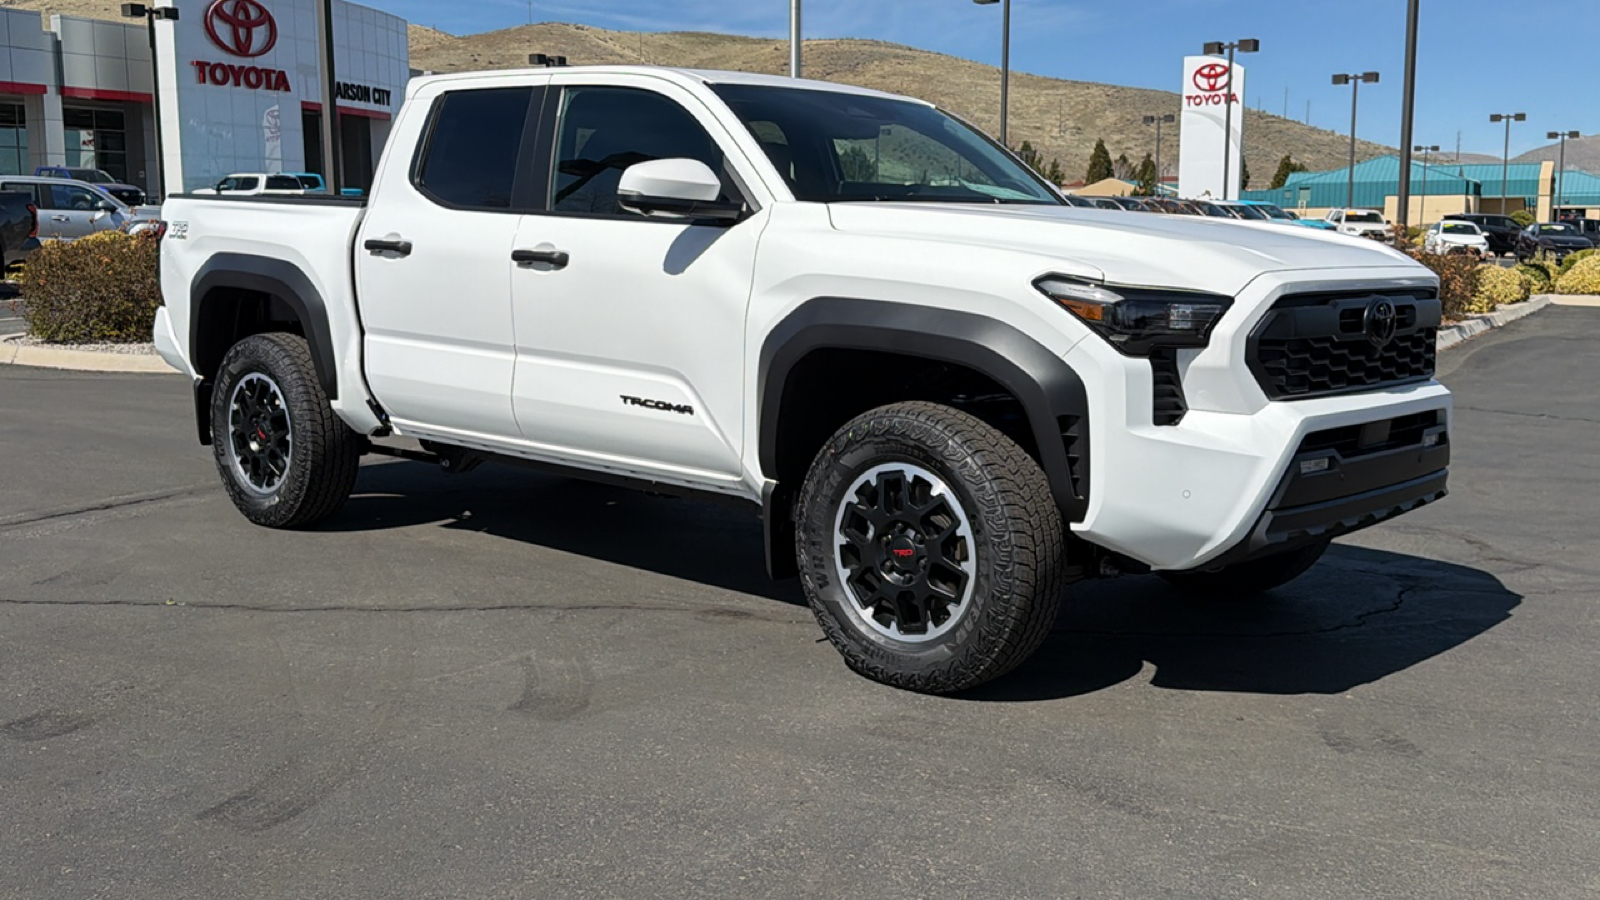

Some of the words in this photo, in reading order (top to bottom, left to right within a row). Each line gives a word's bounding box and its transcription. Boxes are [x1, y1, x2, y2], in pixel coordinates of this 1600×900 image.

[190, 60, 291, 92] TOYOTA
[335, 80, 371, 103] ARSON
[372, 87, 391, 106] CITY
[1185, 92, 1240, 107] TOYOTA
[619, 394, 695, 416] TACOMA
[892, 548, 915, 558] TRD
